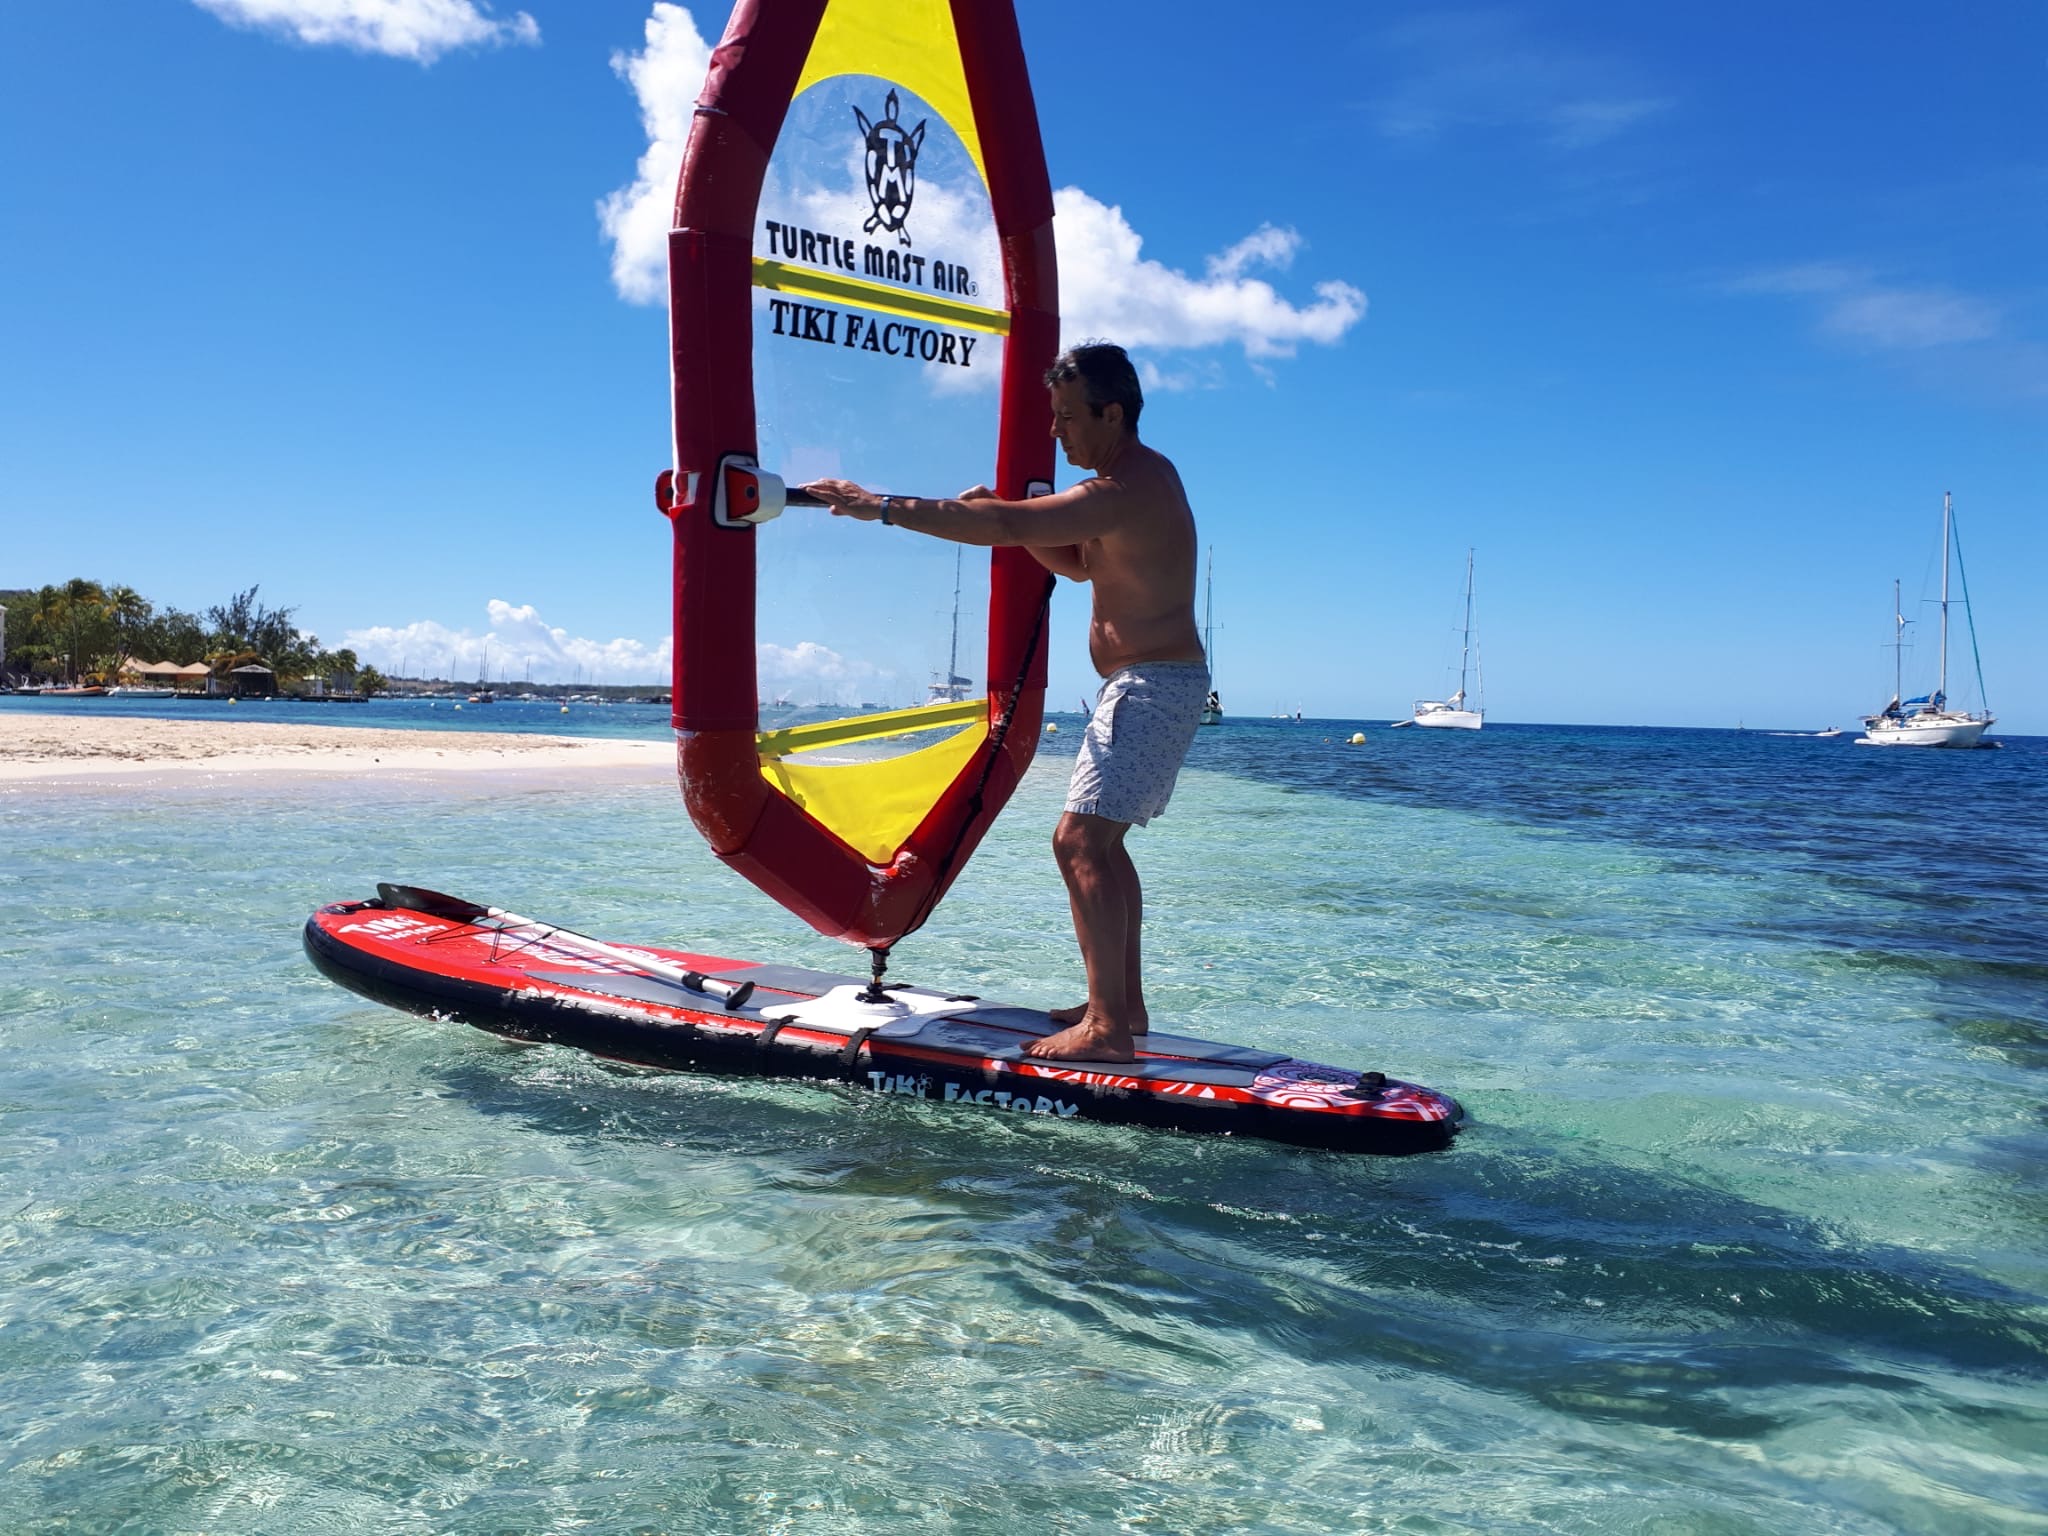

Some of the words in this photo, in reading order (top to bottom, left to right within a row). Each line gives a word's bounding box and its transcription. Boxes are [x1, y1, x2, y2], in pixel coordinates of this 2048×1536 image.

[766, 220, 855, 272] TURTLE
[864, 244, 925, 286] MAST
[769, 298, 838, 344] TIKI
[844, 313, 977, 367] FACTORY
[944, 1083, 1079, 1117] FACTORY
